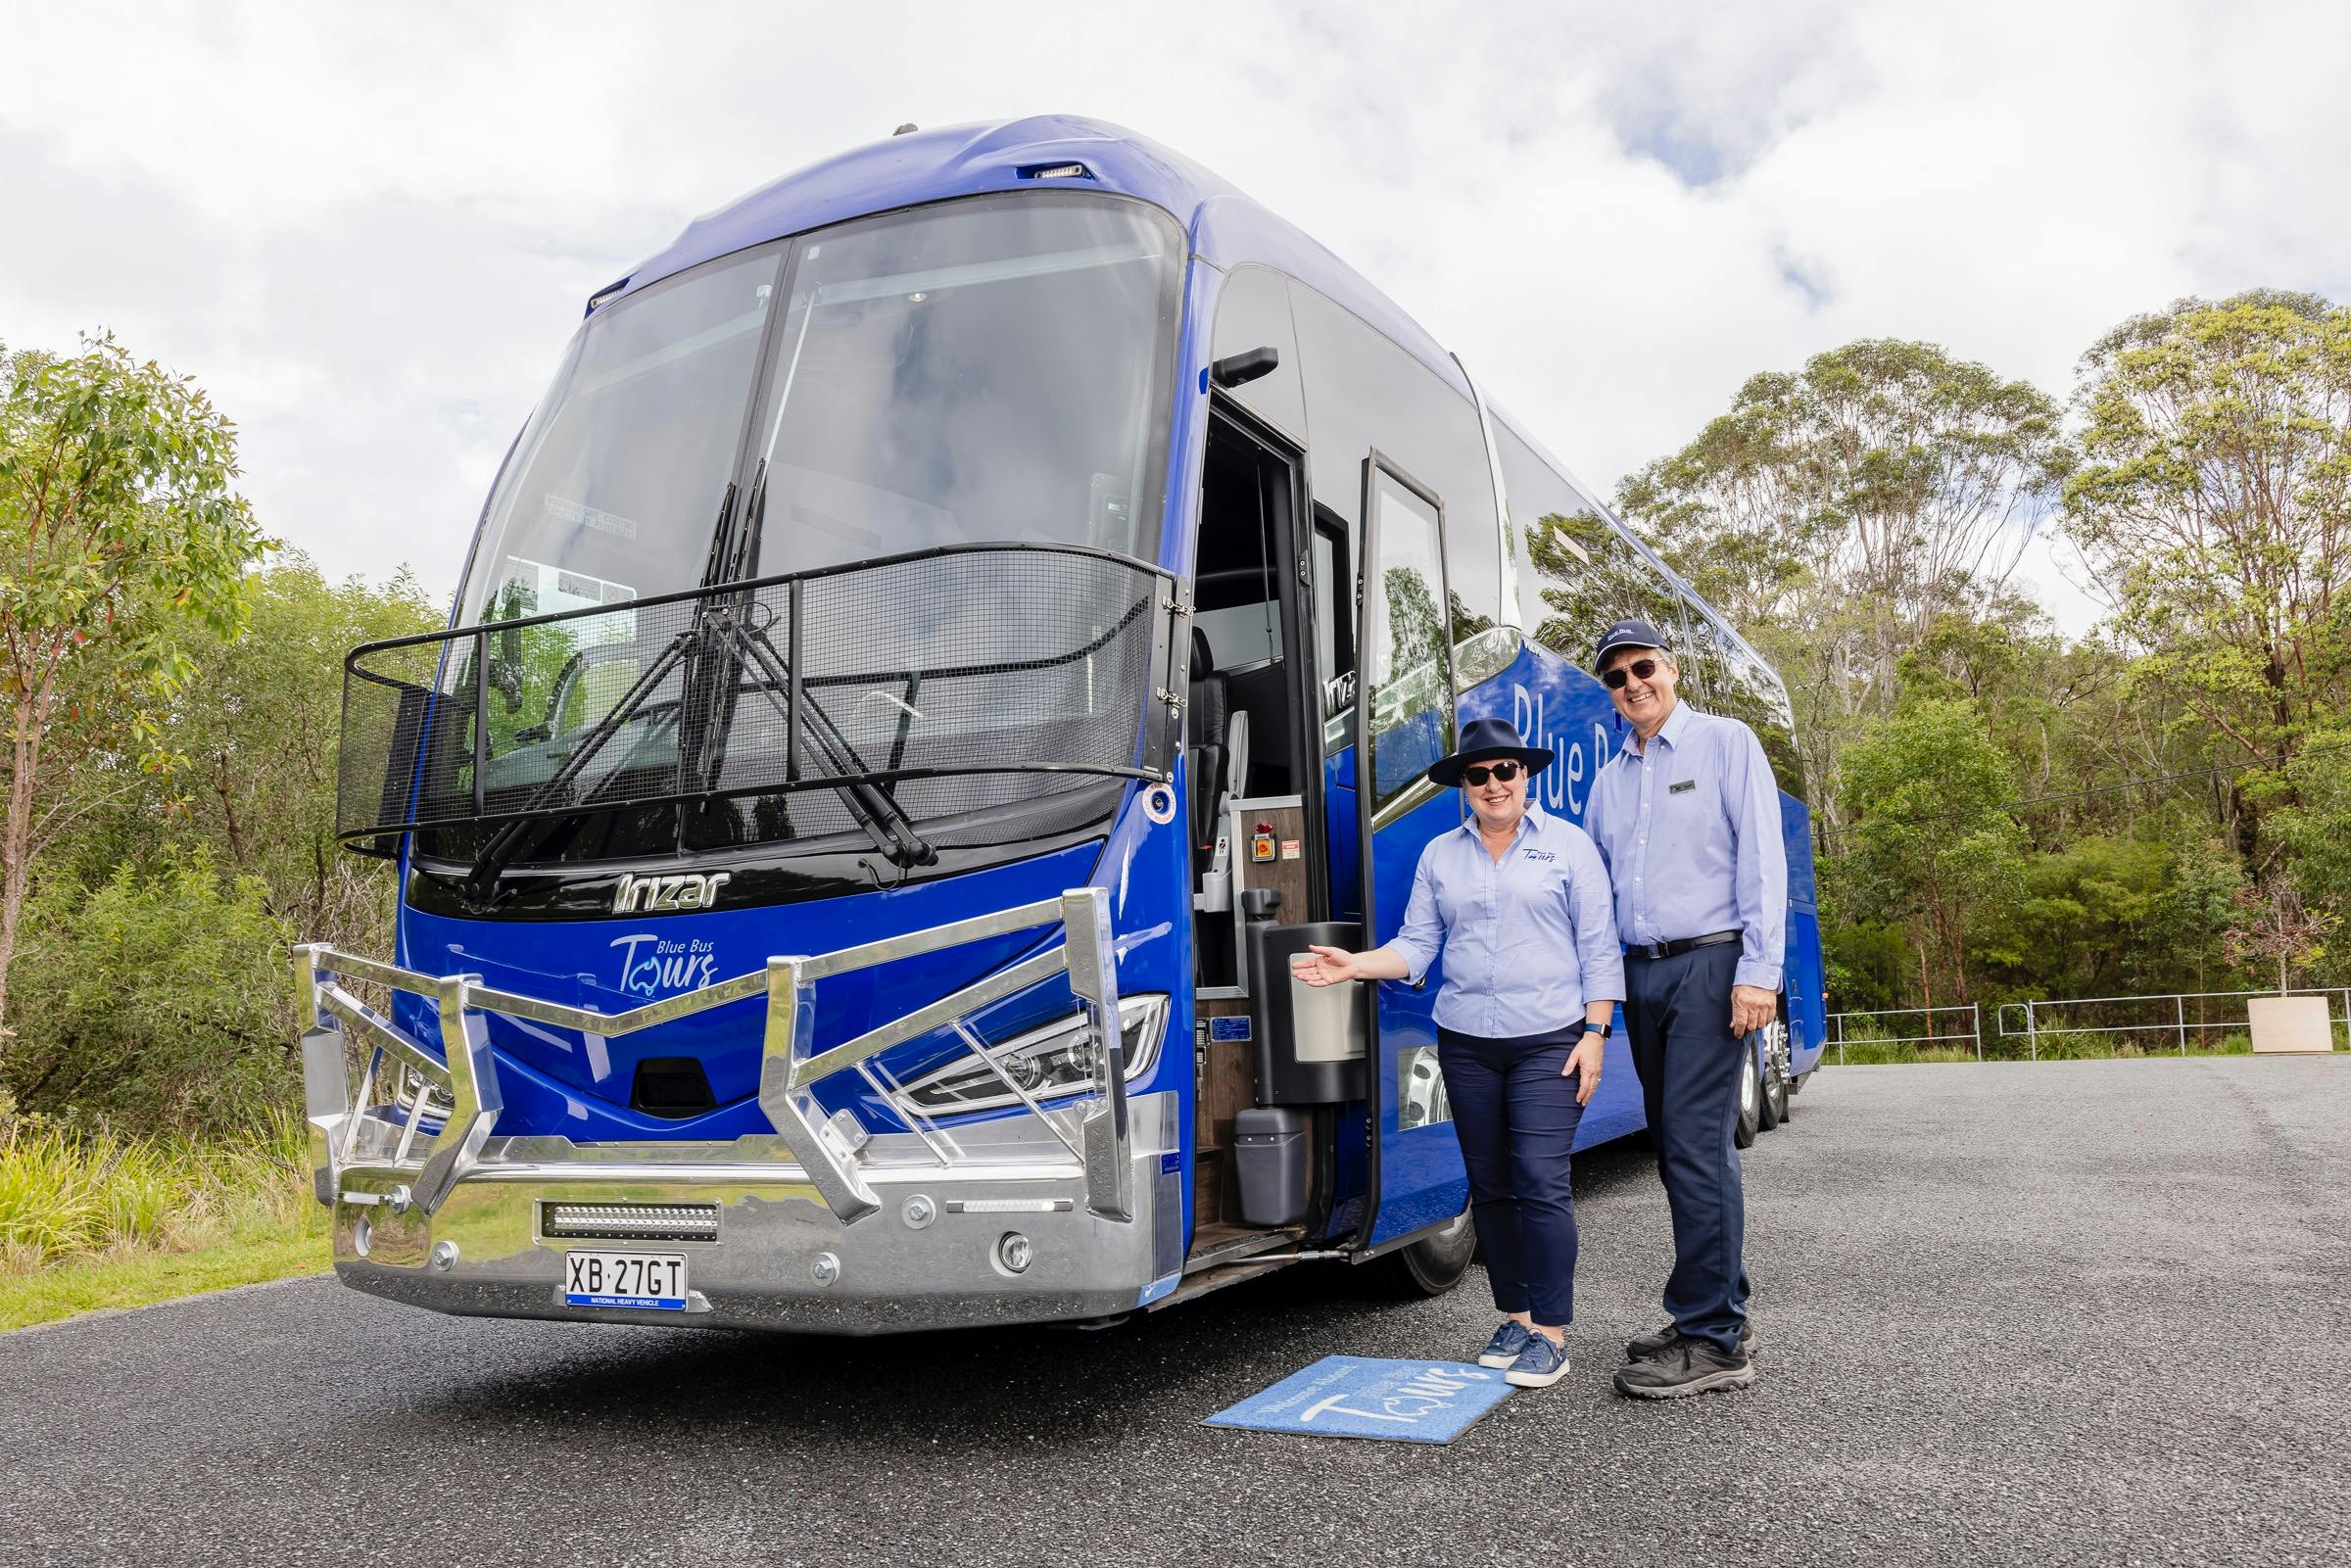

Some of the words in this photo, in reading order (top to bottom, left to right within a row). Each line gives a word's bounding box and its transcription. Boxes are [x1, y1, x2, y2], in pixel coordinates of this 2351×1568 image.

[612, 872, 731, 915] Irizar
[609, 933, 719, 997] Tours
[656, 940, 686, 955] Blue
[690, 938, 714, 953] Bus
[1300, 1366, 1491, 1423] Tours
